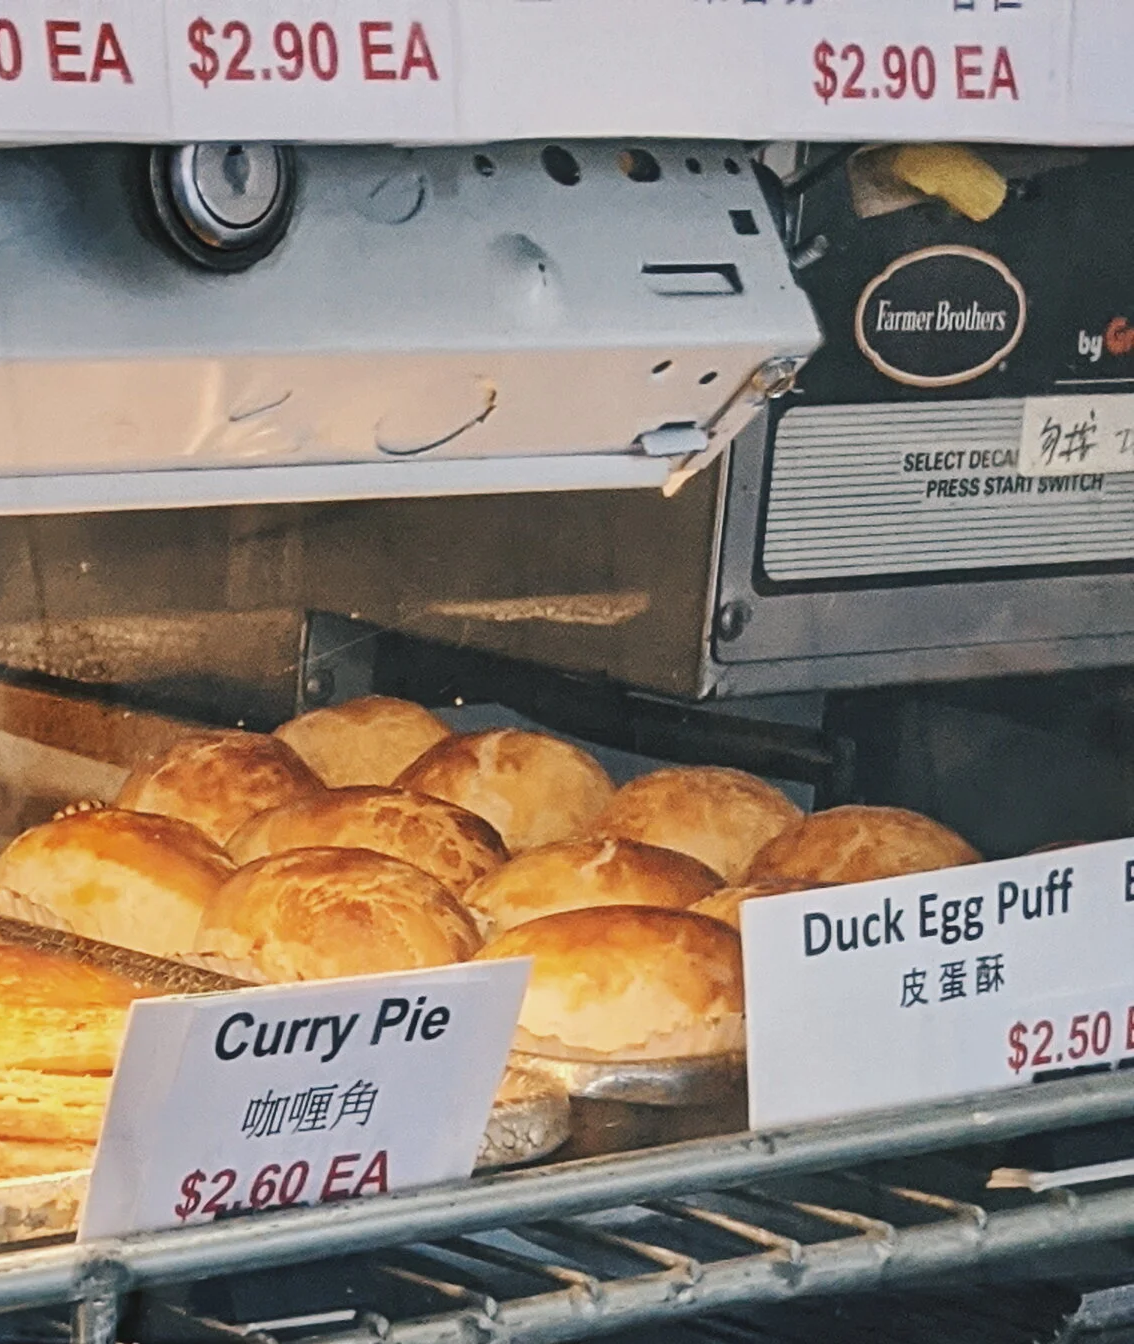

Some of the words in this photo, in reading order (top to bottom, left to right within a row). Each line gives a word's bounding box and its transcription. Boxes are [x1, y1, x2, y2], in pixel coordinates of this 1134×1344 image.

[45, 20, 134, 85] EA
[187, 19, 339, 89] $2.90
[361, 21, 439, 81] EA
[813, 41, 936, 105] $2.90
[955, 45, 1020, 100] EA
[876, 299, 934, 332] Farmer
[935, 299, 1007, 332] Brothers
[1078, 329, 1103, 362] by
[903, 451, 965, 472] SELECT
[969, 449, 1020, 469] DECA
[926, 477, 980, 498] PRESS
[983, 475, 1034, 496] START
[1037, 473, 1105, 493] SWITCH
[803, 897, 905, 957] Duck
[919, 893, 984, 946] Egg
[998, 867, 1074, 925] Puff
[900, 953, 1005, 1009] 皮蛋酥
[214, 1009, 360, 1063] Curry
[370, 996, 450, 1046] Pie
[1007, 1010, 1112, 1075] $2.50
[241, 1079, 379, 1140] 咖喱角
[175, 1160, 309, 1220] $2.60
[320, 1150, 388, 1202] EA
